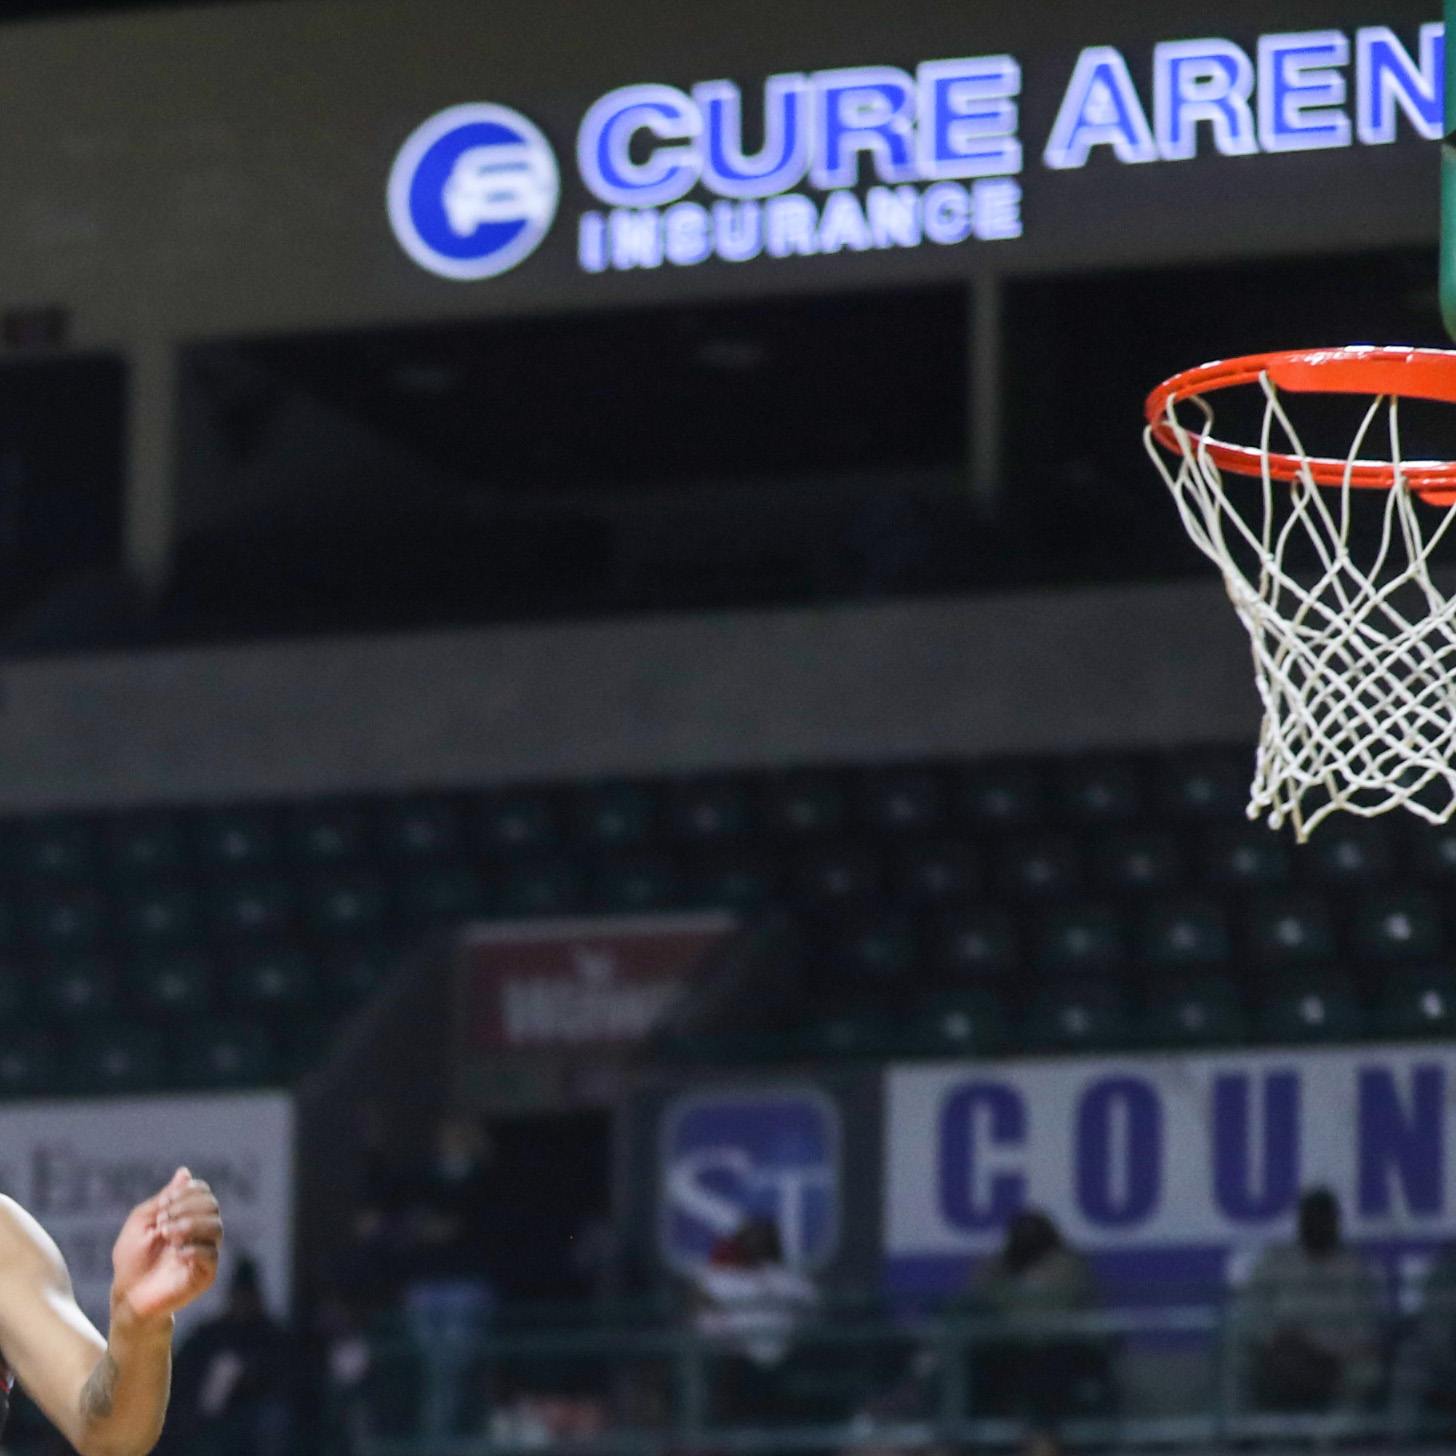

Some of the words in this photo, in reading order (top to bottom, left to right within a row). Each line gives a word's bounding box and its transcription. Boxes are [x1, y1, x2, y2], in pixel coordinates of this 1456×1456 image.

[576, 54, 1022, 208] CURE
[577, 175, 1023, 274] INSURANCE
[934, 1062, 1448, 1235] COUN
